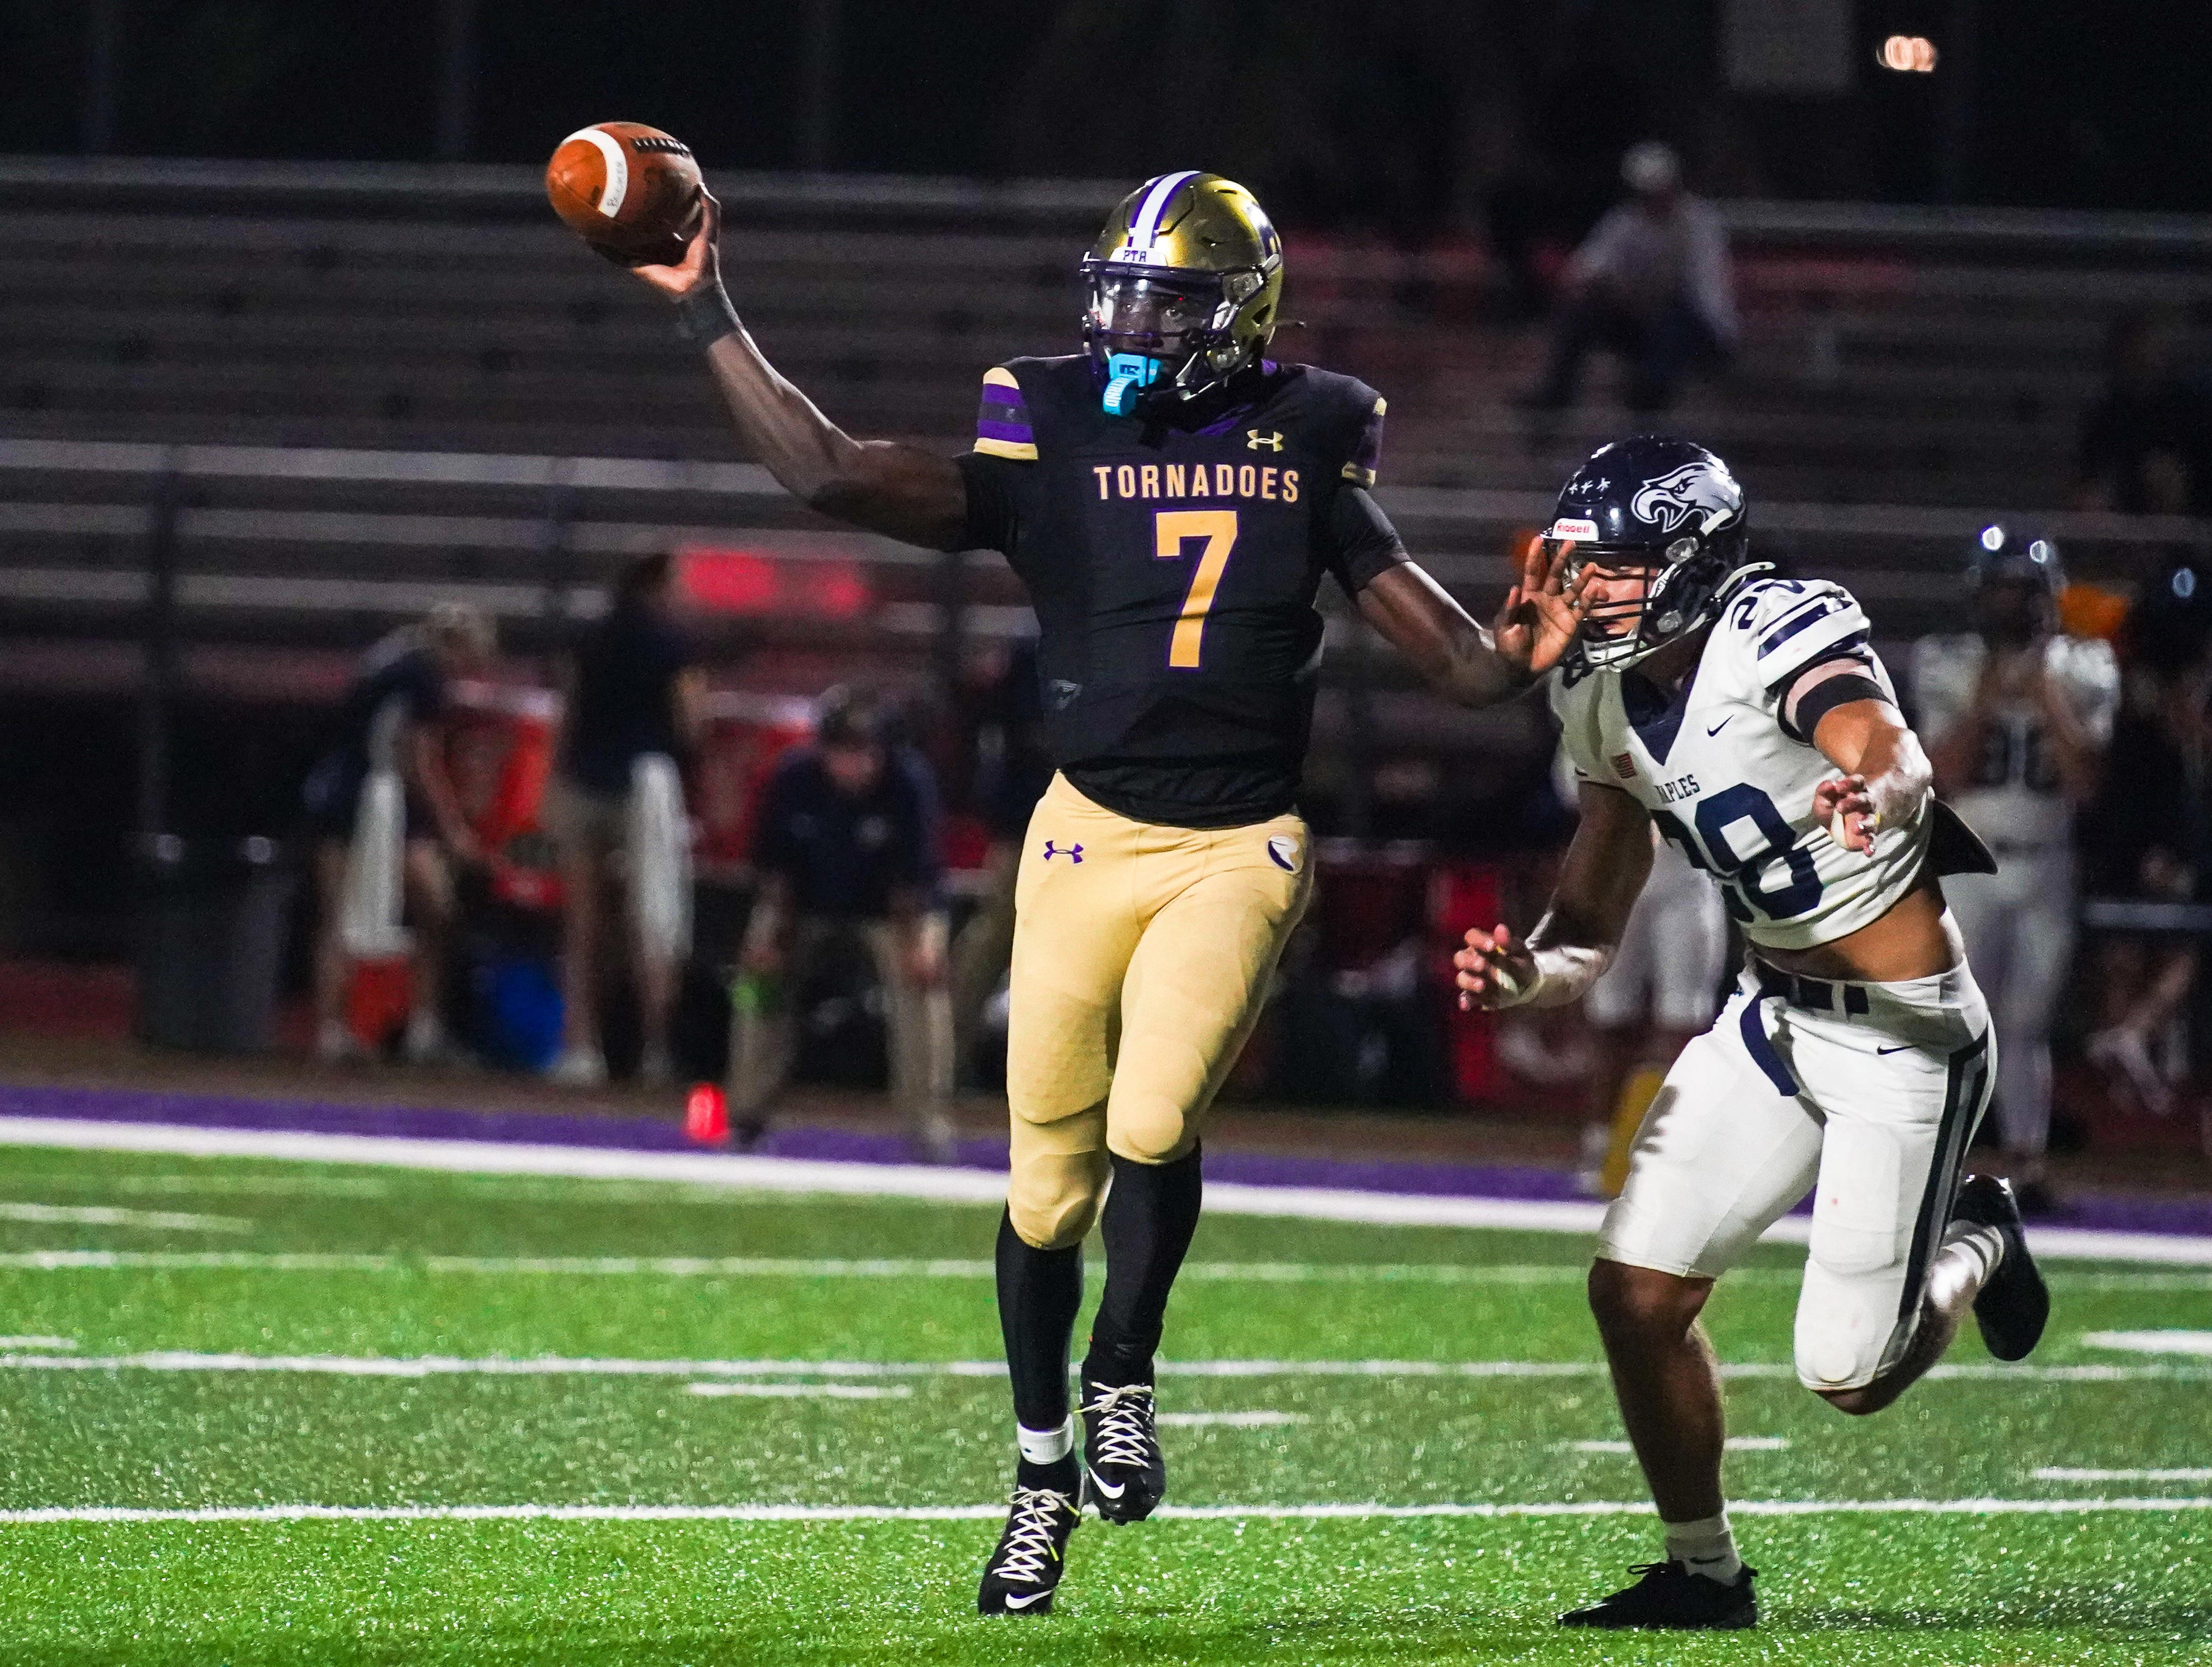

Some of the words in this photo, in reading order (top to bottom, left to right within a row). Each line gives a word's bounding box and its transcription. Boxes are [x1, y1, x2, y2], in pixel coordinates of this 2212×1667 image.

[1123, 249, 1147, 262] PTA
[1093, 464, 1300, 502] TORNADOES
[1154, 508, 1239, 669] 7
